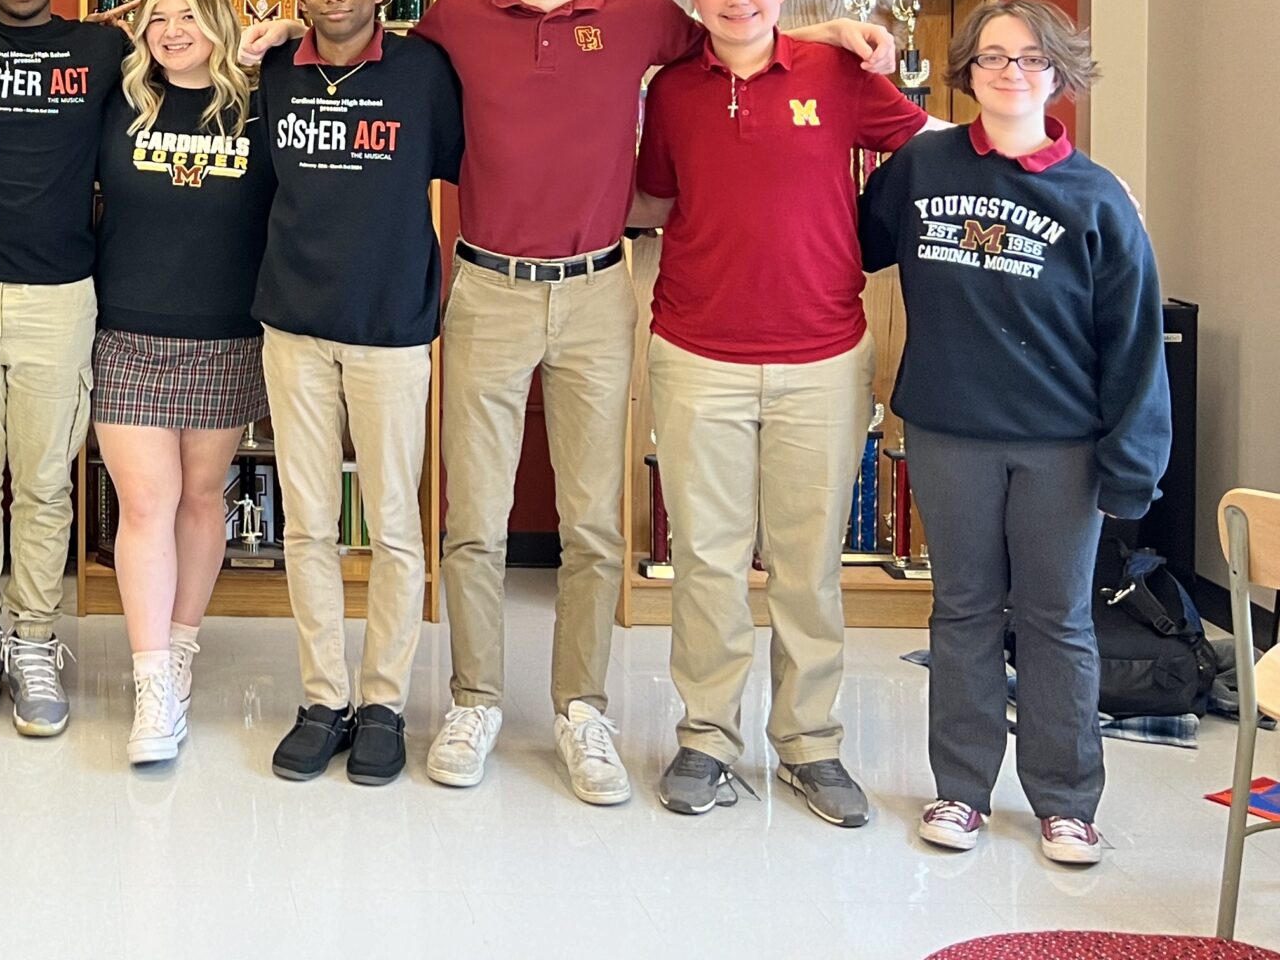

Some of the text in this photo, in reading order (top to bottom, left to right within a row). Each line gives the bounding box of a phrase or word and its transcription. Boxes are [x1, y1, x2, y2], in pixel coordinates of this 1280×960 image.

[50, 67, 89, 96] ACT
[789, 99, 820, 126] M
[135, 130, 251, 157] CARDINALS
[277, 108, 401, 154] SISTER ACT
[133, 147, 249, 170] SOCCER
[364, 152, 392, 161] MUSICAL
[172, 164, 204, 188] M
[914, 195, 1066, 245] YOUNGSTOWN
[926, 219, 1043, 256] EST. M 1956
[917, 244, 1044, 279] CARDINAL MOONEY
